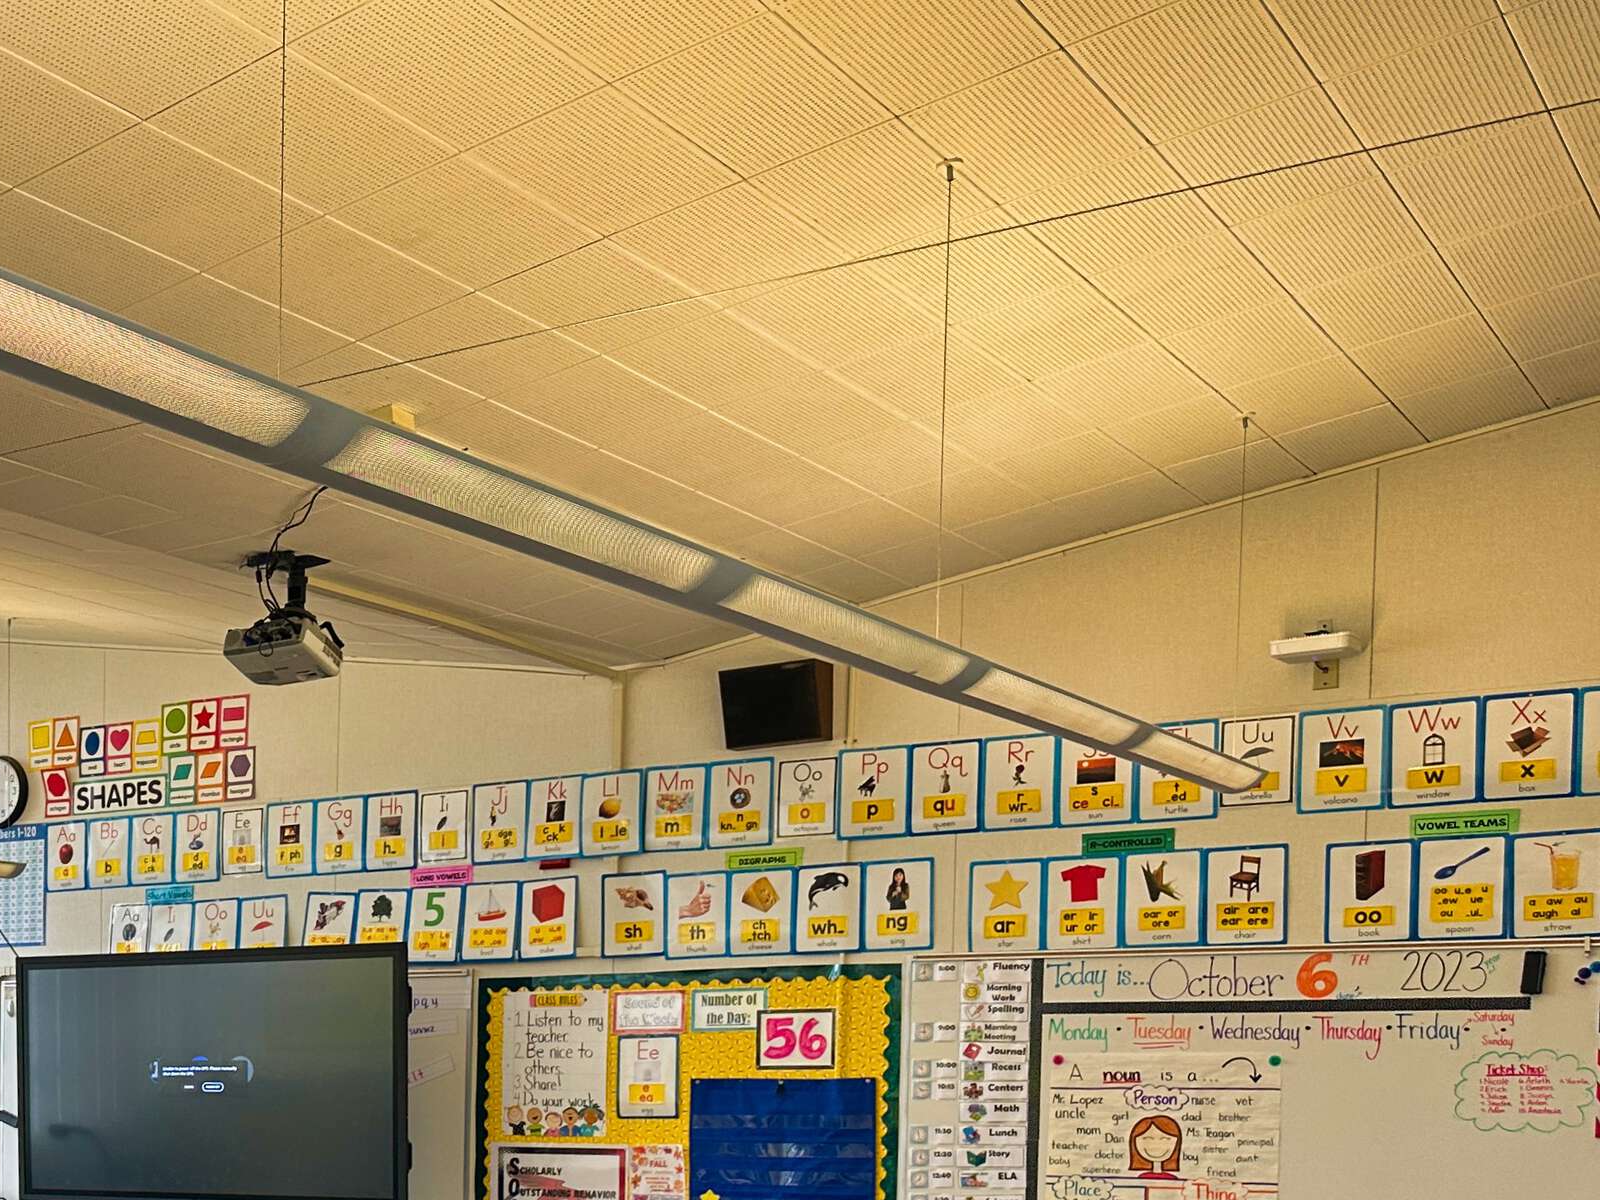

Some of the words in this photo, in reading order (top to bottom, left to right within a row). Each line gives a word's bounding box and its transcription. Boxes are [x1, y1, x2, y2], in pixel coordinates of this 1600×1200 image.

[1512, 700, 1546, 725] Xx
[1327, 715, 1358, 739] Vv
[1408, 707, 1461, 733] Ww
[1243, 723, 1274, 744] Uu
[1008, 742, 1035, 763] Rr
[862, 753, 889, 784] Pp
[928, 747, 968, 777] Qq
[727, 766, 755, 787] Nn
[793, 763, 823, 782] Oo
[603, 776, 619, 797] Ll
[658, 771, 694, 793] Mm
[1518, 784, 1535, 793] box
[76, 779, 163, 812] SHAPES
[547, 781, 567, 800] Kk
[1416, 789, 1450, 800] window
[379, 798, 403, 817] Hh
[491, 786, 509, 815] Jj
[933, 797, 955, 814] qu
[1072, 799, 1089, 810] ce
[1323, 796, 1358, 806] volcano
[282, 805, 302, 823] Ff
[327, 802, 352, 827] Gg
[1164, 804, 1188, 815] turtle
[142, 818, 163, 836] Cc
[186, 814, 208, 832] Dd
[235, 813, 250, 829] Ee
[1418, 820, 1460, 831] VOWEL
[1463, 817, 1507, 829] TEAMS
[18, 826, 37, 838] 1-120
[57, 829, 76, 843] Aa
[100, 823, 119, 840] Bb
[1089, 837, 1163, 849] R-CONTROLLED
[289, 849, 301, 860] ph
[738, 855, 787, 866] DIGRAPHS
[416, 873, 435, 882] LONG
[436, 871, 466, 881] VOWELS
[1546, 897, 1562, 905] aw
[1574, 895, 1588, 904] au
[424, 891, 446, 927] 5
[1144, 910, 1161, 919] oar
[1167, 909, 1179, 918] or
[1224, 904, 1240, 914] air
[1248, 905, 1268, 914] are
[1532, 908, 1558, 919] augh
[886, 916, 908, 931] ng
[1152, 919, 1170, 928] ore
[1221, 916, 1241, 926] ear
[1248, 916, 1268, 925] ere
[1354, 910, 1382, 924] oo
[624, 924, 642, 938] sh
[752, 920, 766, 930] ch
[993, 920, 1016, 934] ar
[1358, 927, 1379, 937] book
[1445, 925, 1474, 935] spoon
[1544, 923, 1572, 932] straw
[688, 926, 706, 940] th
[1152, 933, 1172, 941] corn
[1234, 930, 1256, 939] chair
[1072, 936, 1091, 946] shirt
[993, 962, 1030, 971] Fluency
[1047, 960, 1107, 997] Today
[1149, 956, 1284, 1000] October
[1296, 952, 1338, 999] 6
[1350, 953, 1370, 966] TH
[1400, 950, 1488, 992] 2023
[987, 984, 1022, 993] Morning
[537, 994, 557, 1006] CLASS
[701, 993, 744, 1007] Number
[746, 993, 757, 1005] of
[988, 1005, 1024, 1014] Spelling
[527, 1012, 562, 1028] Listen
[570, 1010, 583, 1027] to
[588, 1016, 604, 1032] my
[707, 1012, 723, 1024] the
[727, 1011, 751, 1026] Day:
[763, 1017, 827, 1060] 56
[1050, 1017, 1108, 1051] Monday
[1127, 1016, 1192, 1047] Tuesday
[1210, 1016, 1301, 1049] Wednesday
[1312, 1015, 1383, 1060] Thursday
[1396, 1013, 1461, 1050] Friday
[1473, 1011, 1515, 1026] Saturday
[1481, 1035, 1514, 1049] Sunday
[526, 1042, 544, 1059] Be
[550, 1046, 573, 1059] nice
[578, 1042, 594, 1059] to
[987, 1046, 1026, 1055] Journal
[992, 1063, 1021, 1071] Recess
[1069, 1063, 1084, 1081] A
[1103, 1070, 1141, 1082] noun
[1160, 1071, 1173, 1081] is
[522, 1075, 562, 1092] Share!
[988, 1083, 1024, 1091] Centers
[522, 1092, 539, 1106] Do
[542, 1096, 563, 1113] your
[1133, 1089, 1178, 1106] Person
[994, 1104, 1020, 1113] Math
[1055, 1108, 1086, 1119] uncle
[1112, 1111, 1129, 1126] girl
[989, 1129, 1018, 1137] Lunch
[1076, 1126, 1101, 1135] mom
[1105, 1132, 1125, 1144] Dan
[1052, 1141, 1089, 1151] teacher
[989, 1150, 1010, 1158] Story
[1094, 1149, 1125, 1159] doctor
[508, 1158, 562, 1177] SCHOLARLY
[649, 1159, 667, 1168] FALL
[998, 1172, 1017, 1181] ELA
[1207, 1166, 1237, 1177] friend
[574, 1190, 617, 1199] BEHAVIOR
[1064, 1180, 1101, 1196] Place
